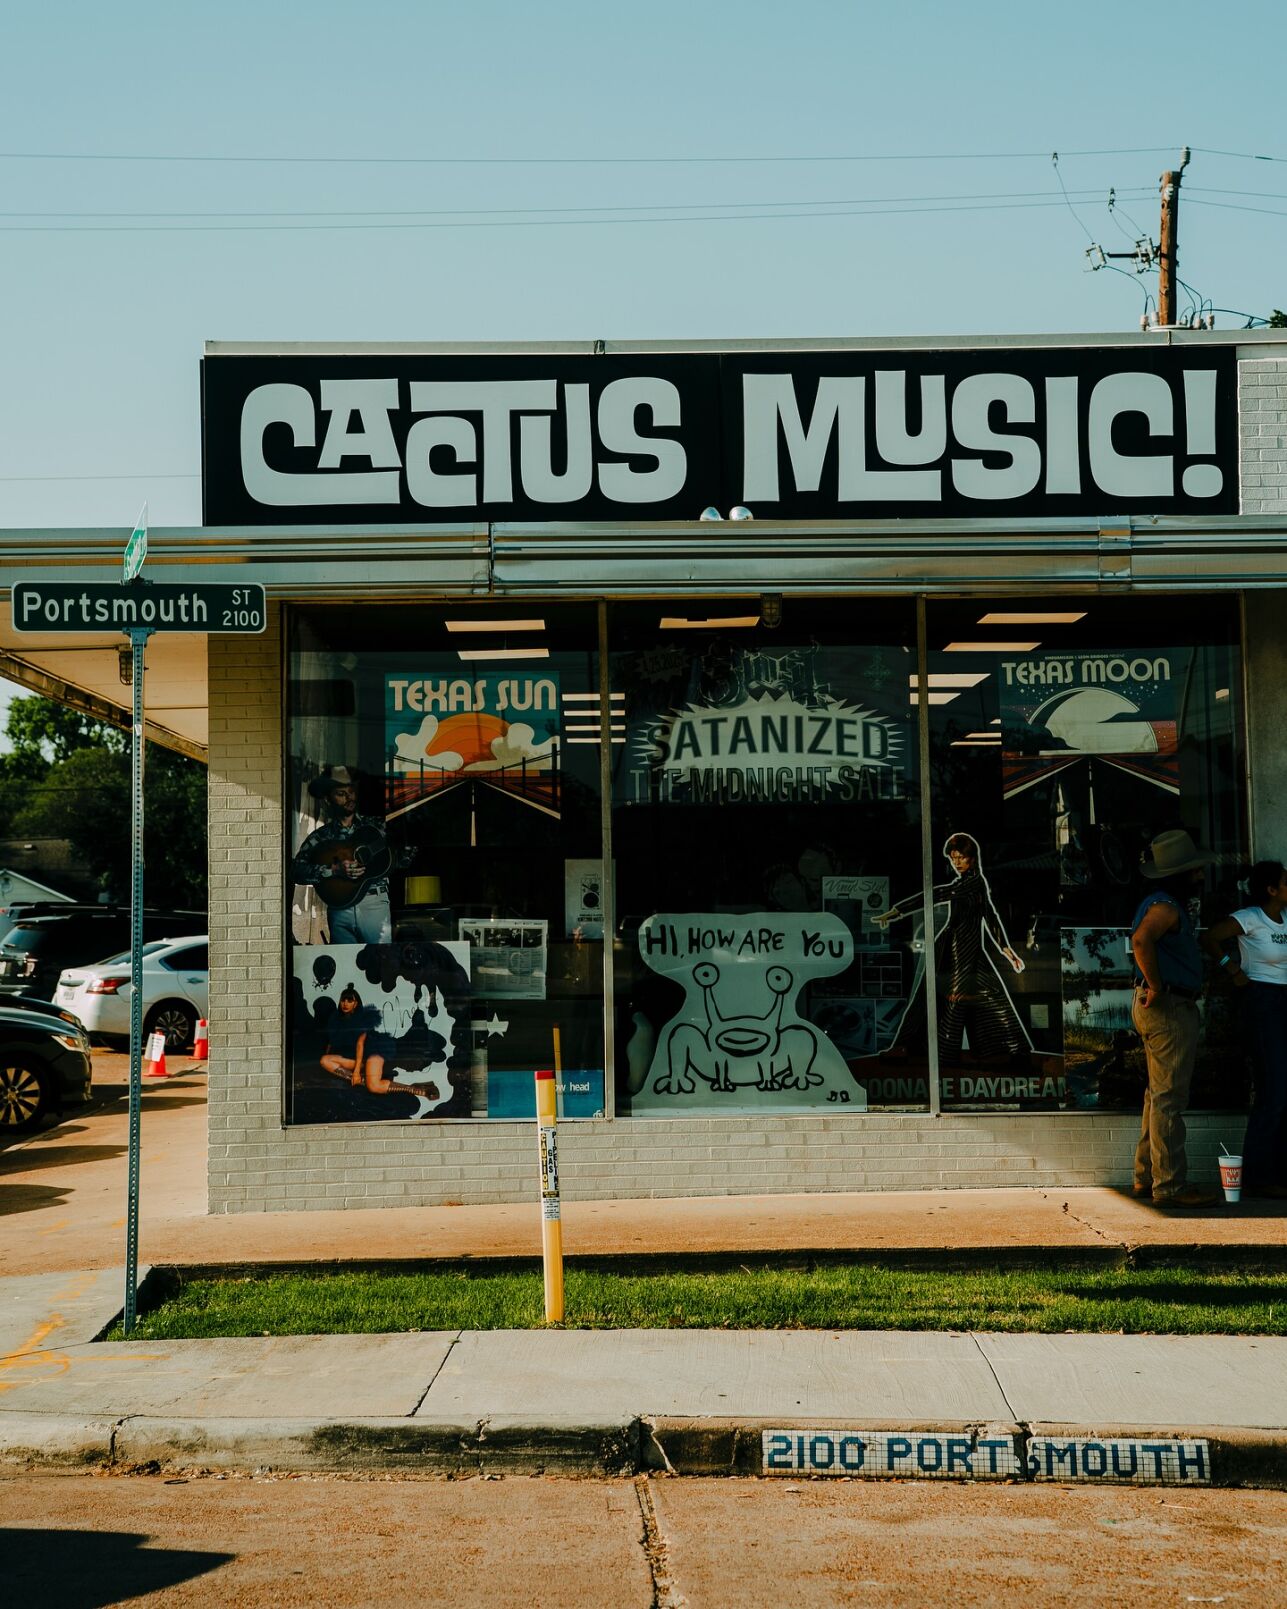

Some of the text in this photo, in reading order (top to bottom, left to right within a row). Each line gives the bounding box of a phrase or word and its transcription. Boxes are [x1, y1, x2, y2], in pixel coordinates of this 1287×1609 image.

[240, 370, 1224, 507] CACTUS MUSIC!
[22, 589, 251, 622] Portsmouth ST
[222, 610, 260, 626] 2100
[1001, 657, 1171, 685] TEXAS MOON
[389, 679, 557, 712] TEXAS SUN
[646, 715, 889, 764] SATANIZED
[629, 765, 906, 803] THE MIDNIGHT SALE
[737, 928, 785, 955] ARE
[801, 929, 844, 958] YOU
[570, 1081, 590, 1092] head
[862, 1077, 954, 1099] OONAE
[540, 1133, 549, 1190] CAUTION
[767, 1436, 865, 1470] 2100
